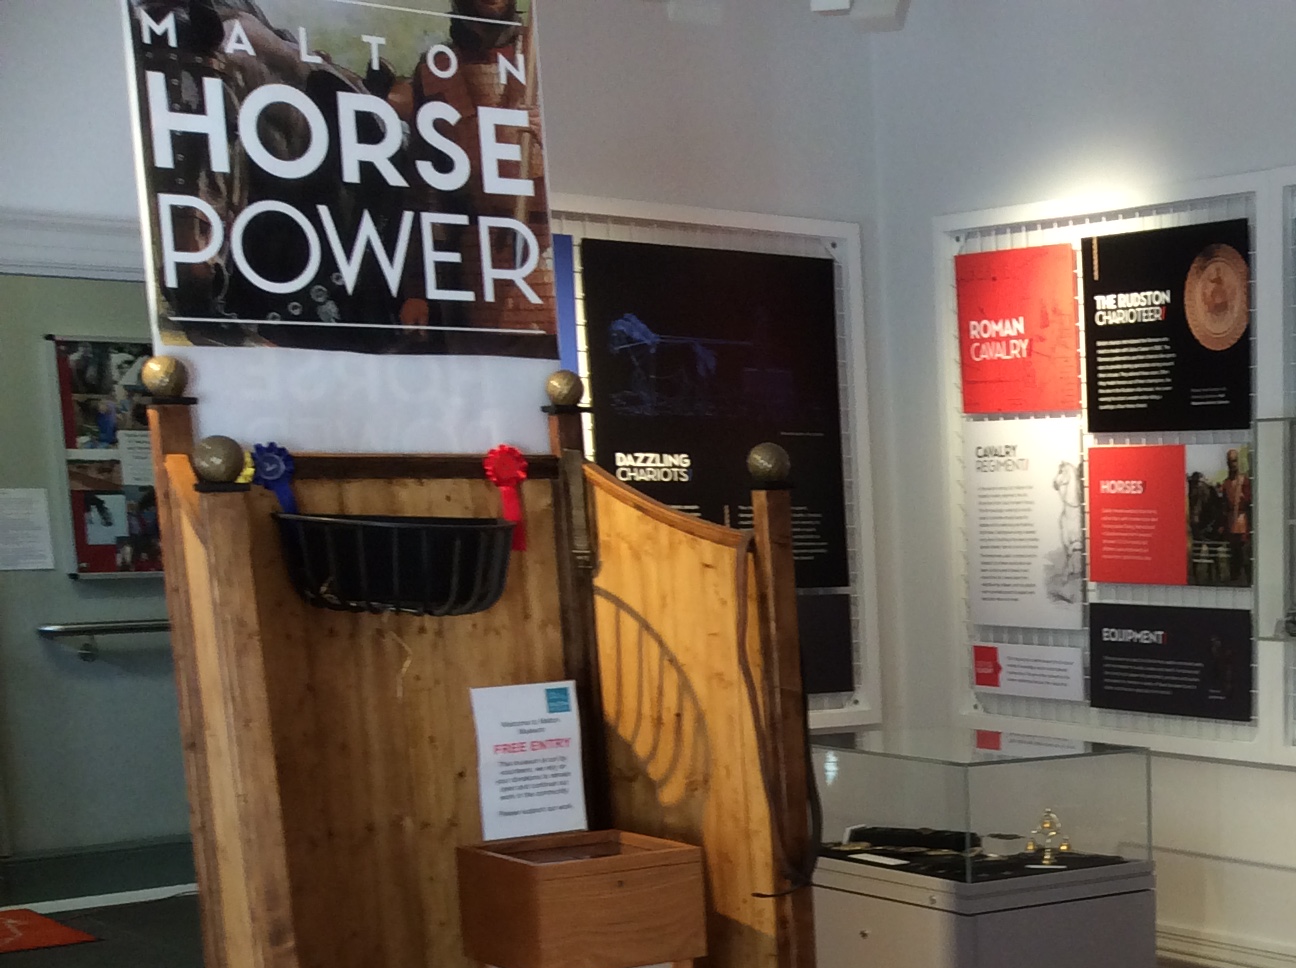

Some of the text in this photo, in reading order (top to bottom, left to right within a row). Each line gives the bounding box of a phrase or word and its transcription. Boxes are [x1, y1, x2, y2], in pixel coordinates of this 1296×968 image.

[140, 9, 526, 86] MALTON
[147, 71, 535, 196] HORSE
[157, 193, 543, 304] POWER
[1094, 290, 1171, 310] THE RUDSTON
[969, 316, 1025, 339] ROMAN
[615, 452, 691, 468] DAZZLING
[975, 445, 1018, 459] CAVALRY
[493, 737, 571, 755] FREE ENTRY
